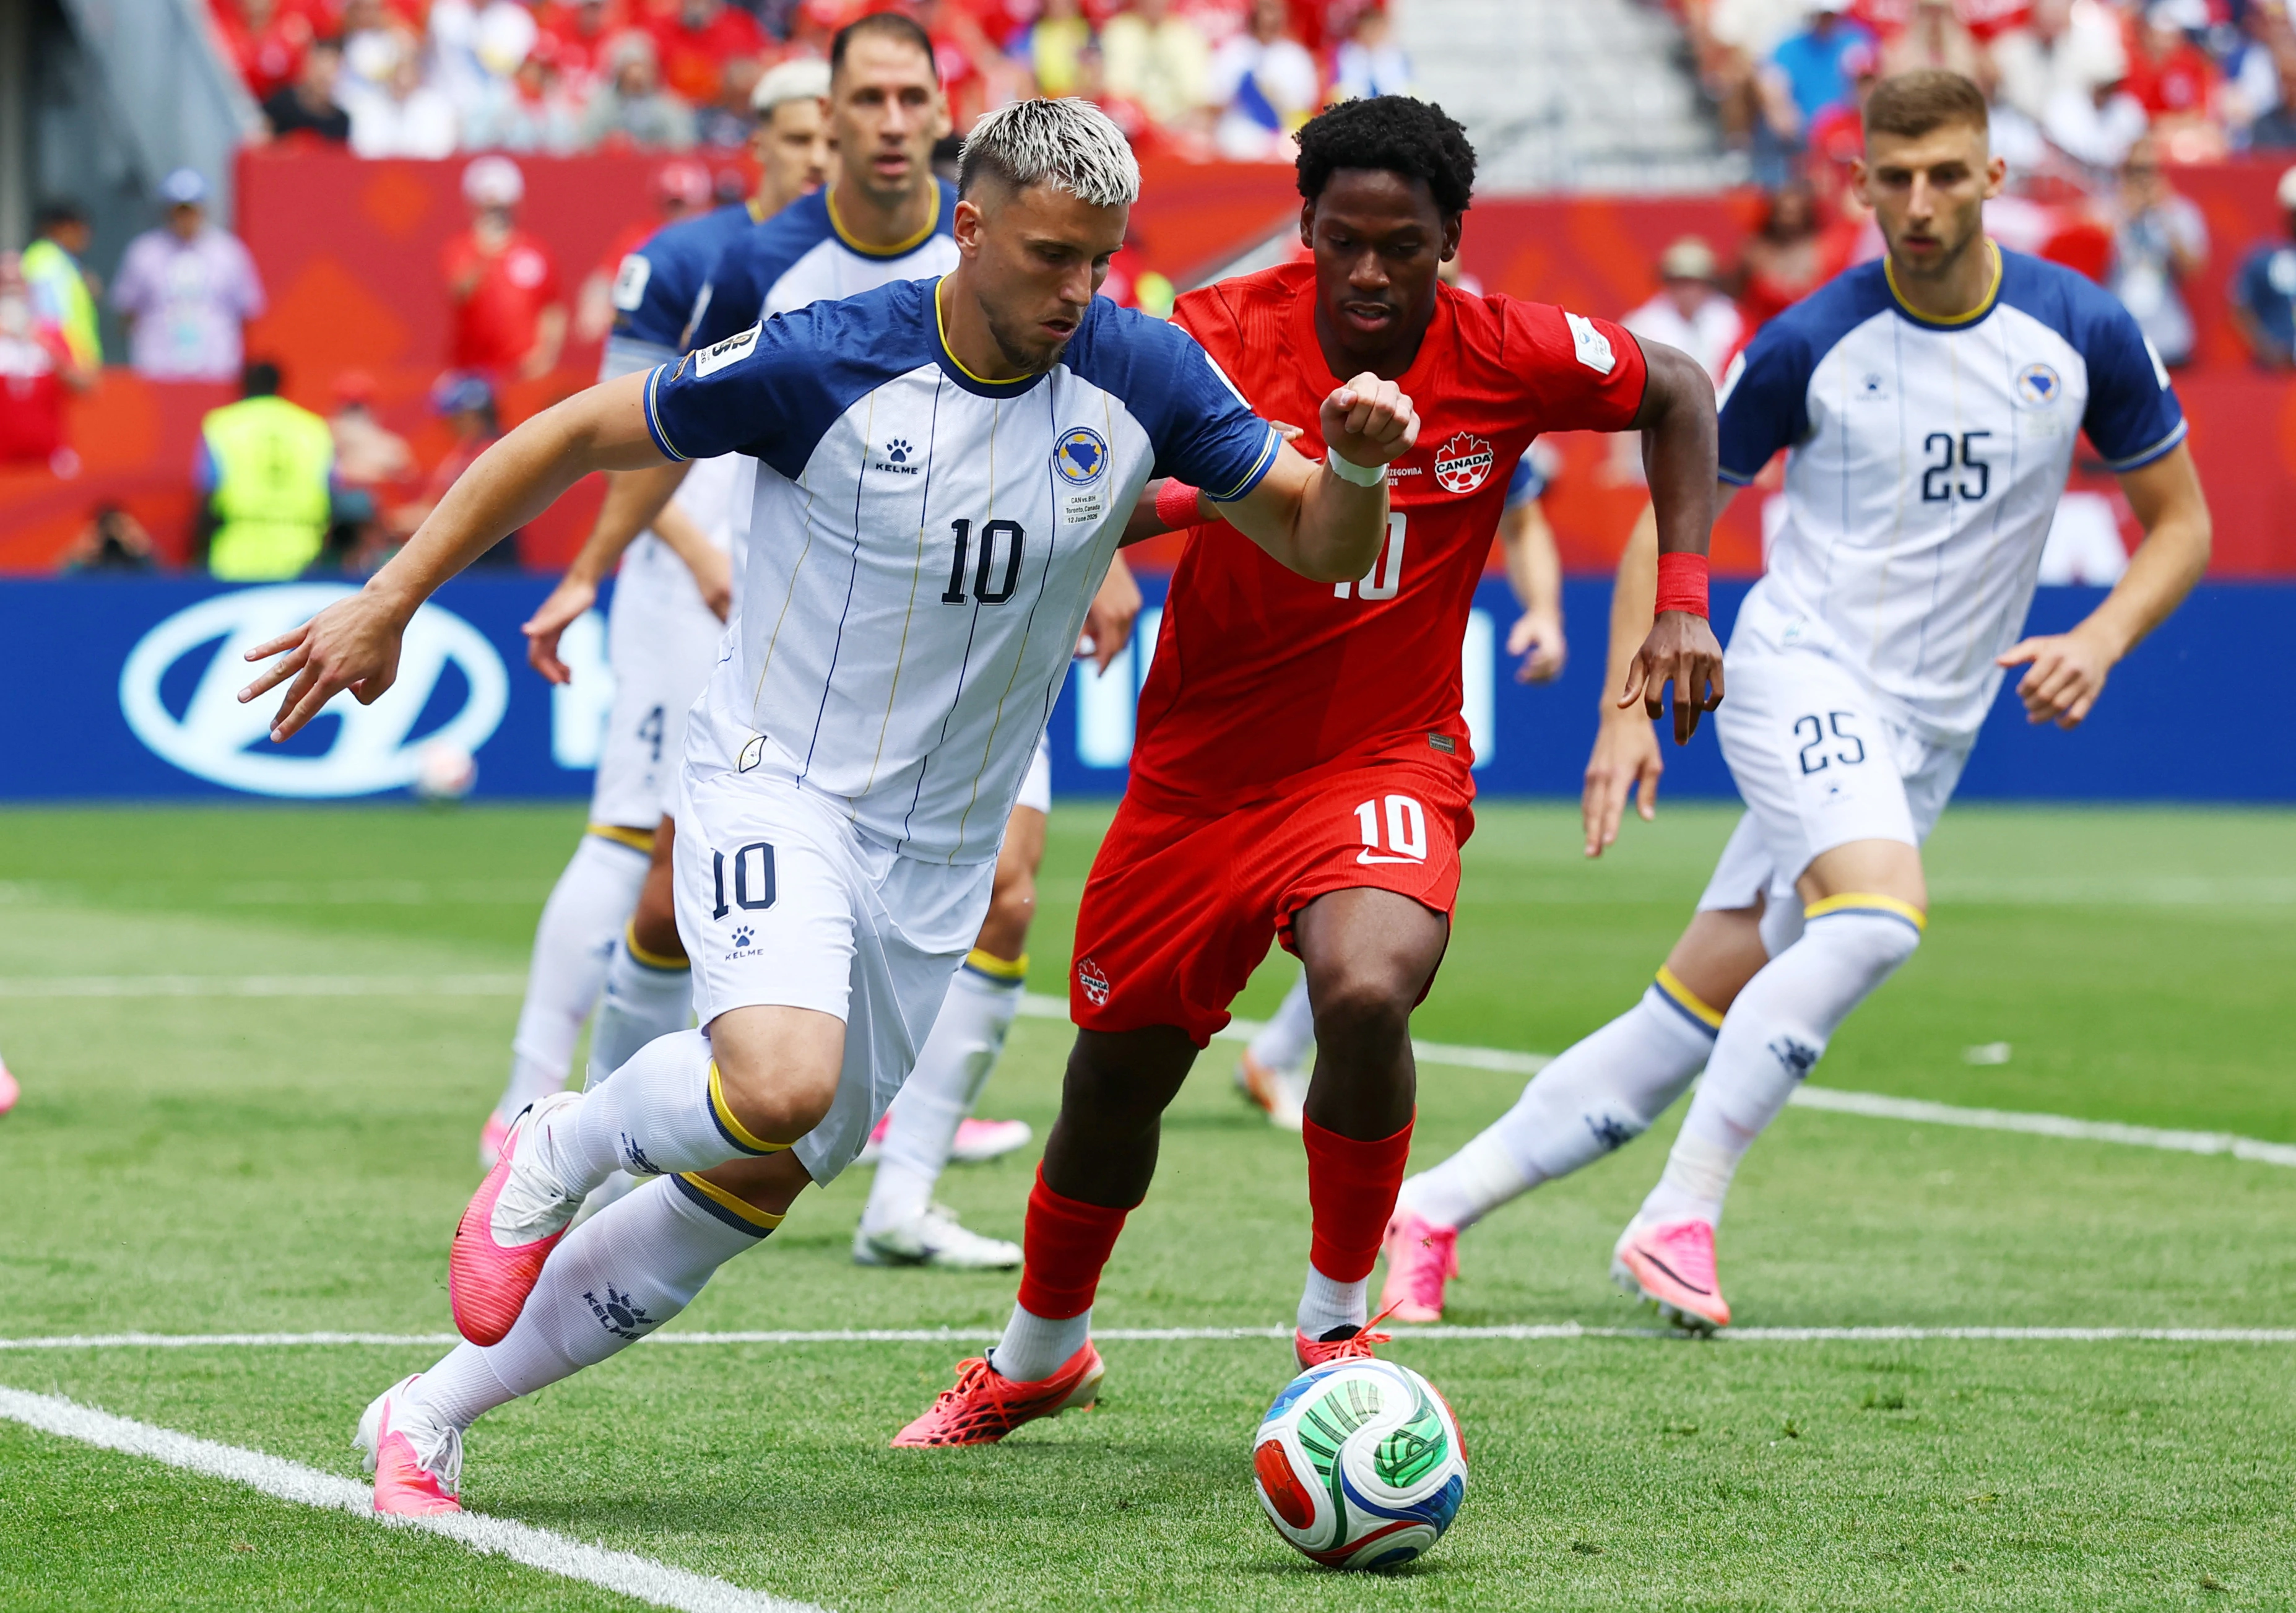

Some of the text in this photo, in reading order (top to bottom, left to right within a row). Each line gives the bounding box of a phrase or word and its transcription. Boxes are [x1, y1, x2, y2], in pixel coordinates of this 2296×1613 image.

[876, 463, 918, 474] KELME
[1387, 467, 1423, 476] RZEGOVINA
[1436, 453, 1491, 473] CANADA
[1923, 432, 1991, 502] 25
[1085, 504, 1100, 512] Canada
[942, 519, 1026, 606] 10
[638, 704, 665, 762] 4
[1794, 712, 1865, 775] 25
[1354, 794, 1427, 859] 10
[710, 842, 779, 922] 10
[725, 949, 764, 962] KELME
[1080, 974, 1108, 991] CANADA
